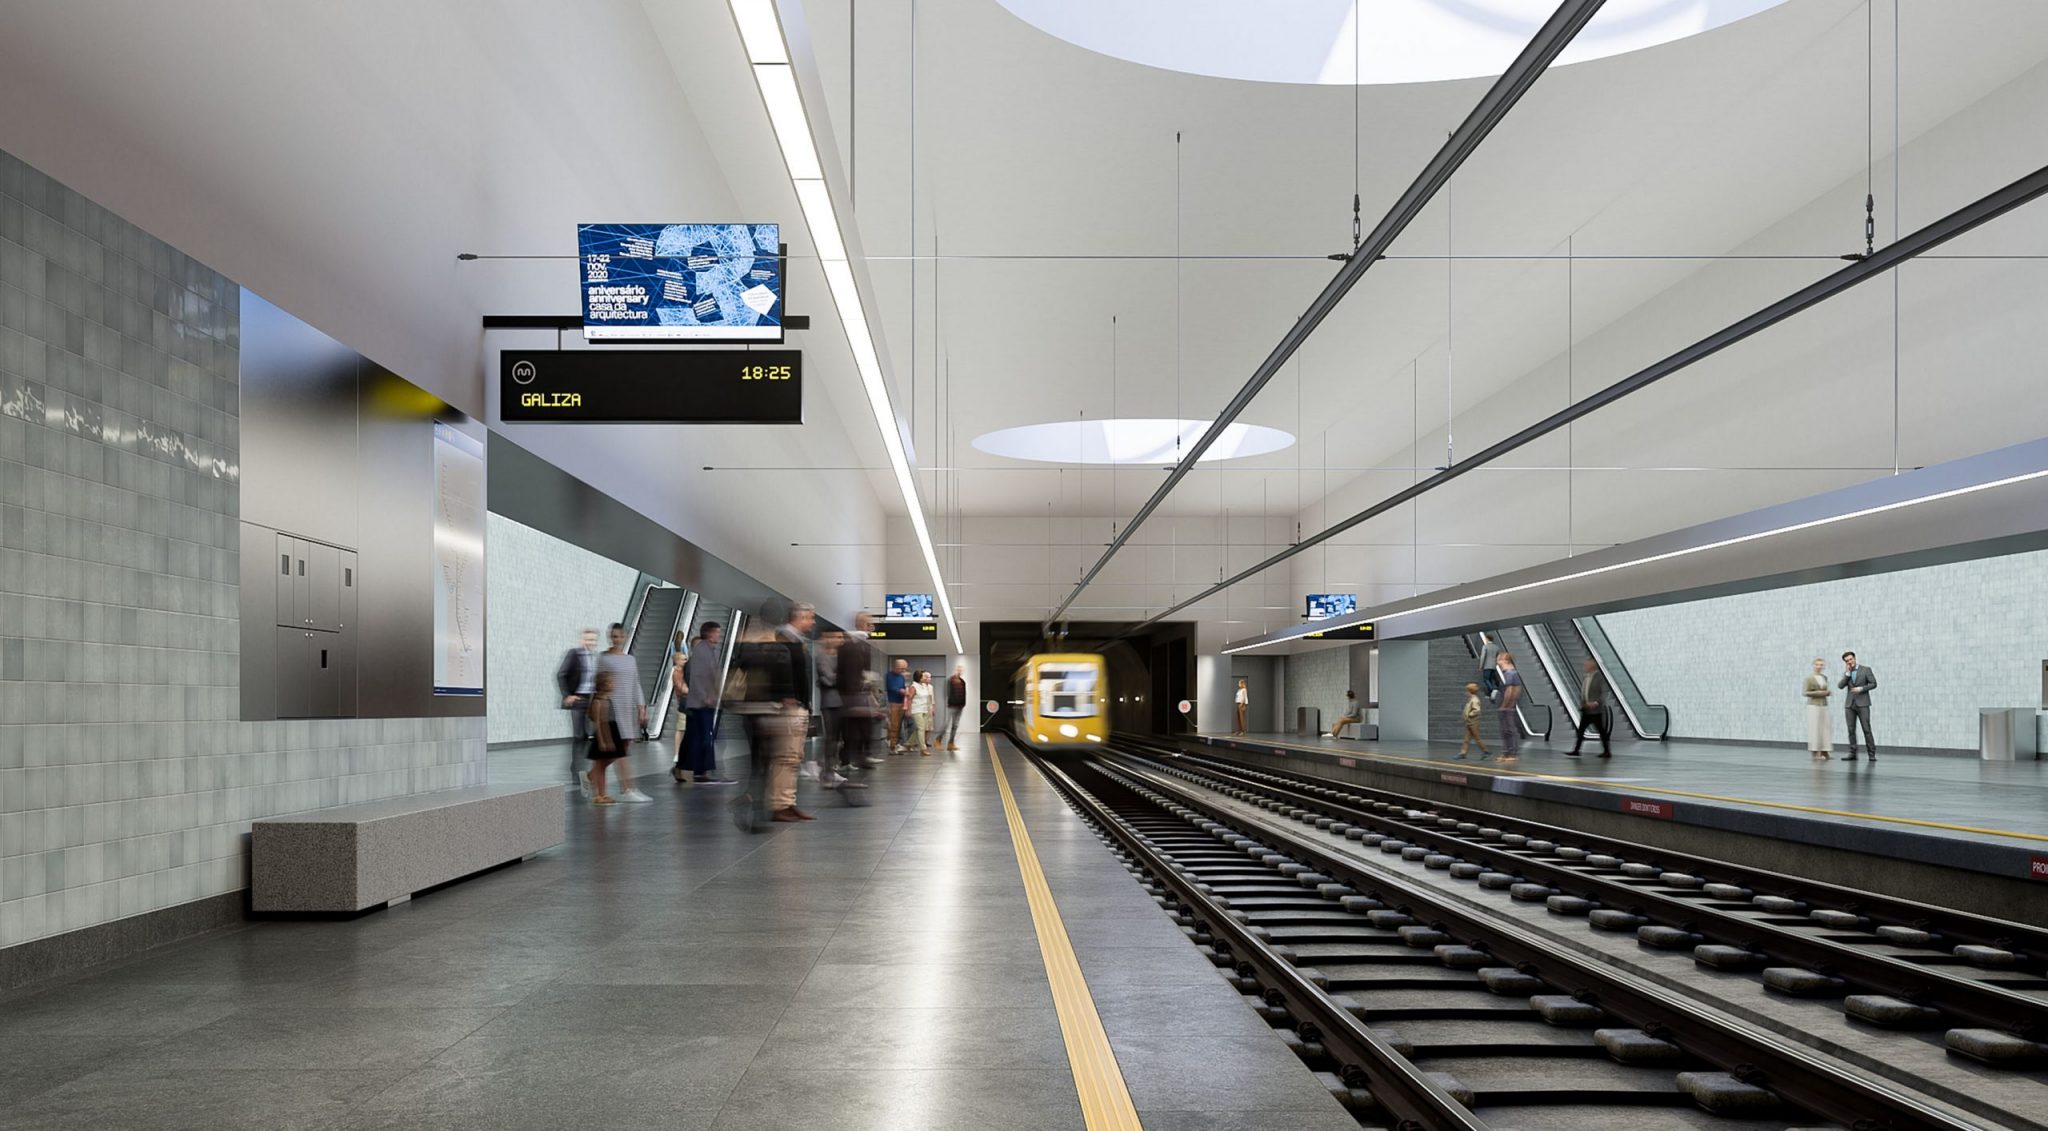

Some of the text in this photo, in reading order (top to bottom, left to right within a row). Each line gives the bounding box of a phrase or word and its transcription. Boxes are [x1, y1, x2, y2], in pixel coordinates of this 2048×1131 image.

[587, 254, 611, 263] 17-22
[588, 270, 608, 279] 2020
[588, 284, 646, 295] aniversário
[589, 294, 650, 306] anniversary
[589, 301, 627, 311] casa da
[589, 310, 648, 321] arquitectura
[742, 366, 791, 380] 18:25
[521, 393, 581, 407] GALIZA
